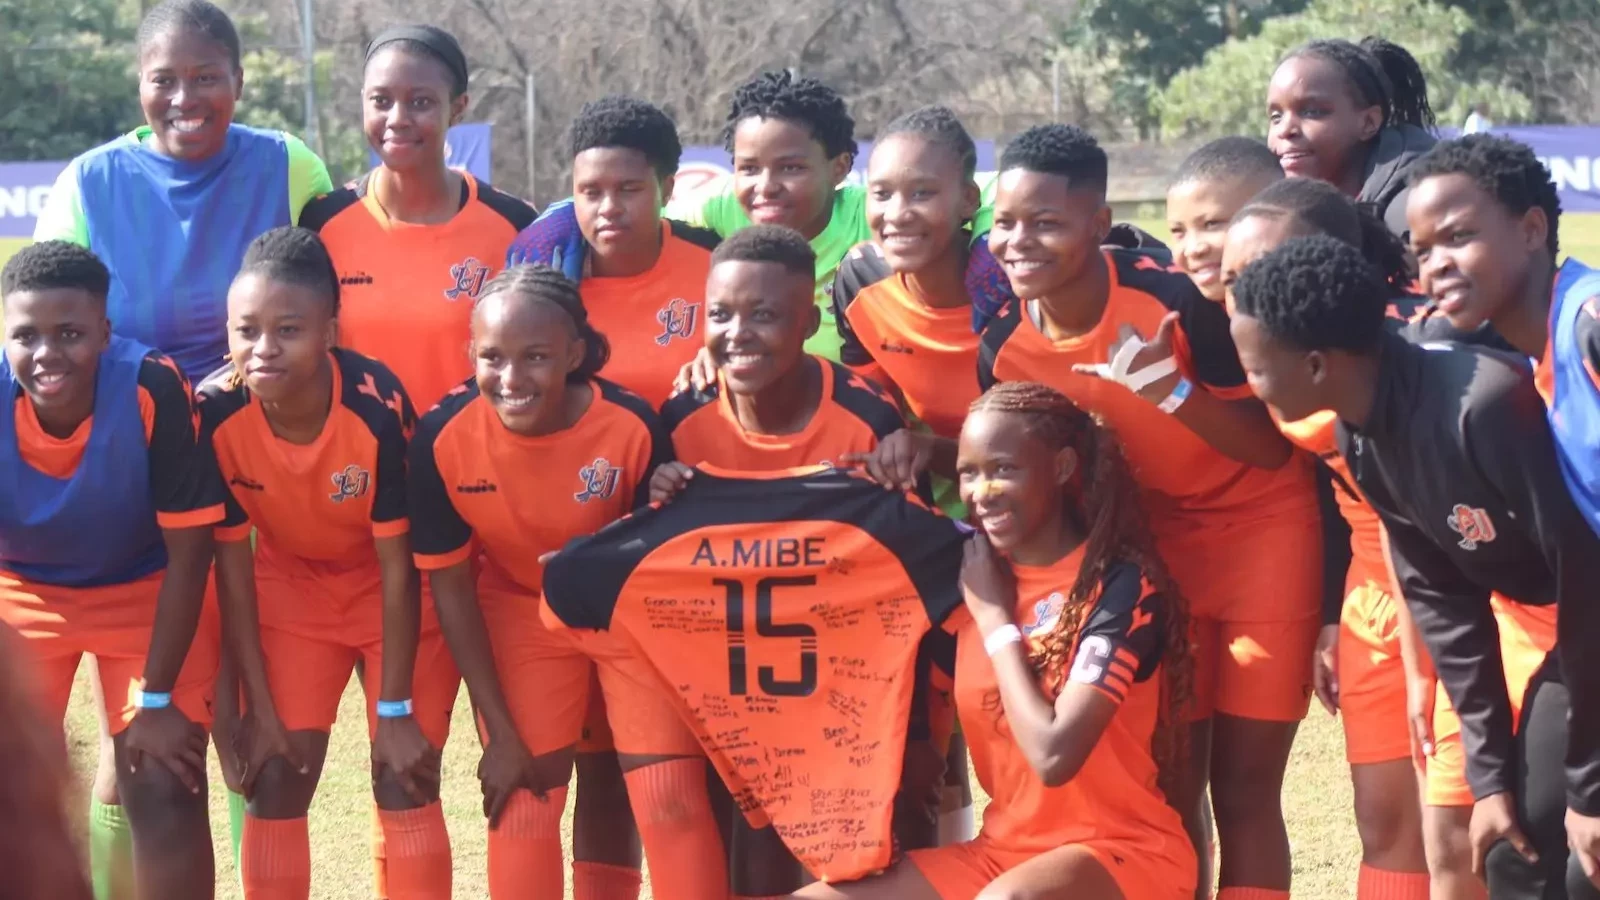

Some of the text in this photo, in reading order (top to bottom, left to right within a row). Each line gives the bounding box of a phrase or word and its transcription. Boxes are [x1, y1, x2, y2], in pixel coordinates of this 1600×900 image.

[690, 537, 827, 567] A.MIBE
[712, 574, 818, 698] 15
[1069, 634, 1112, 684] C
